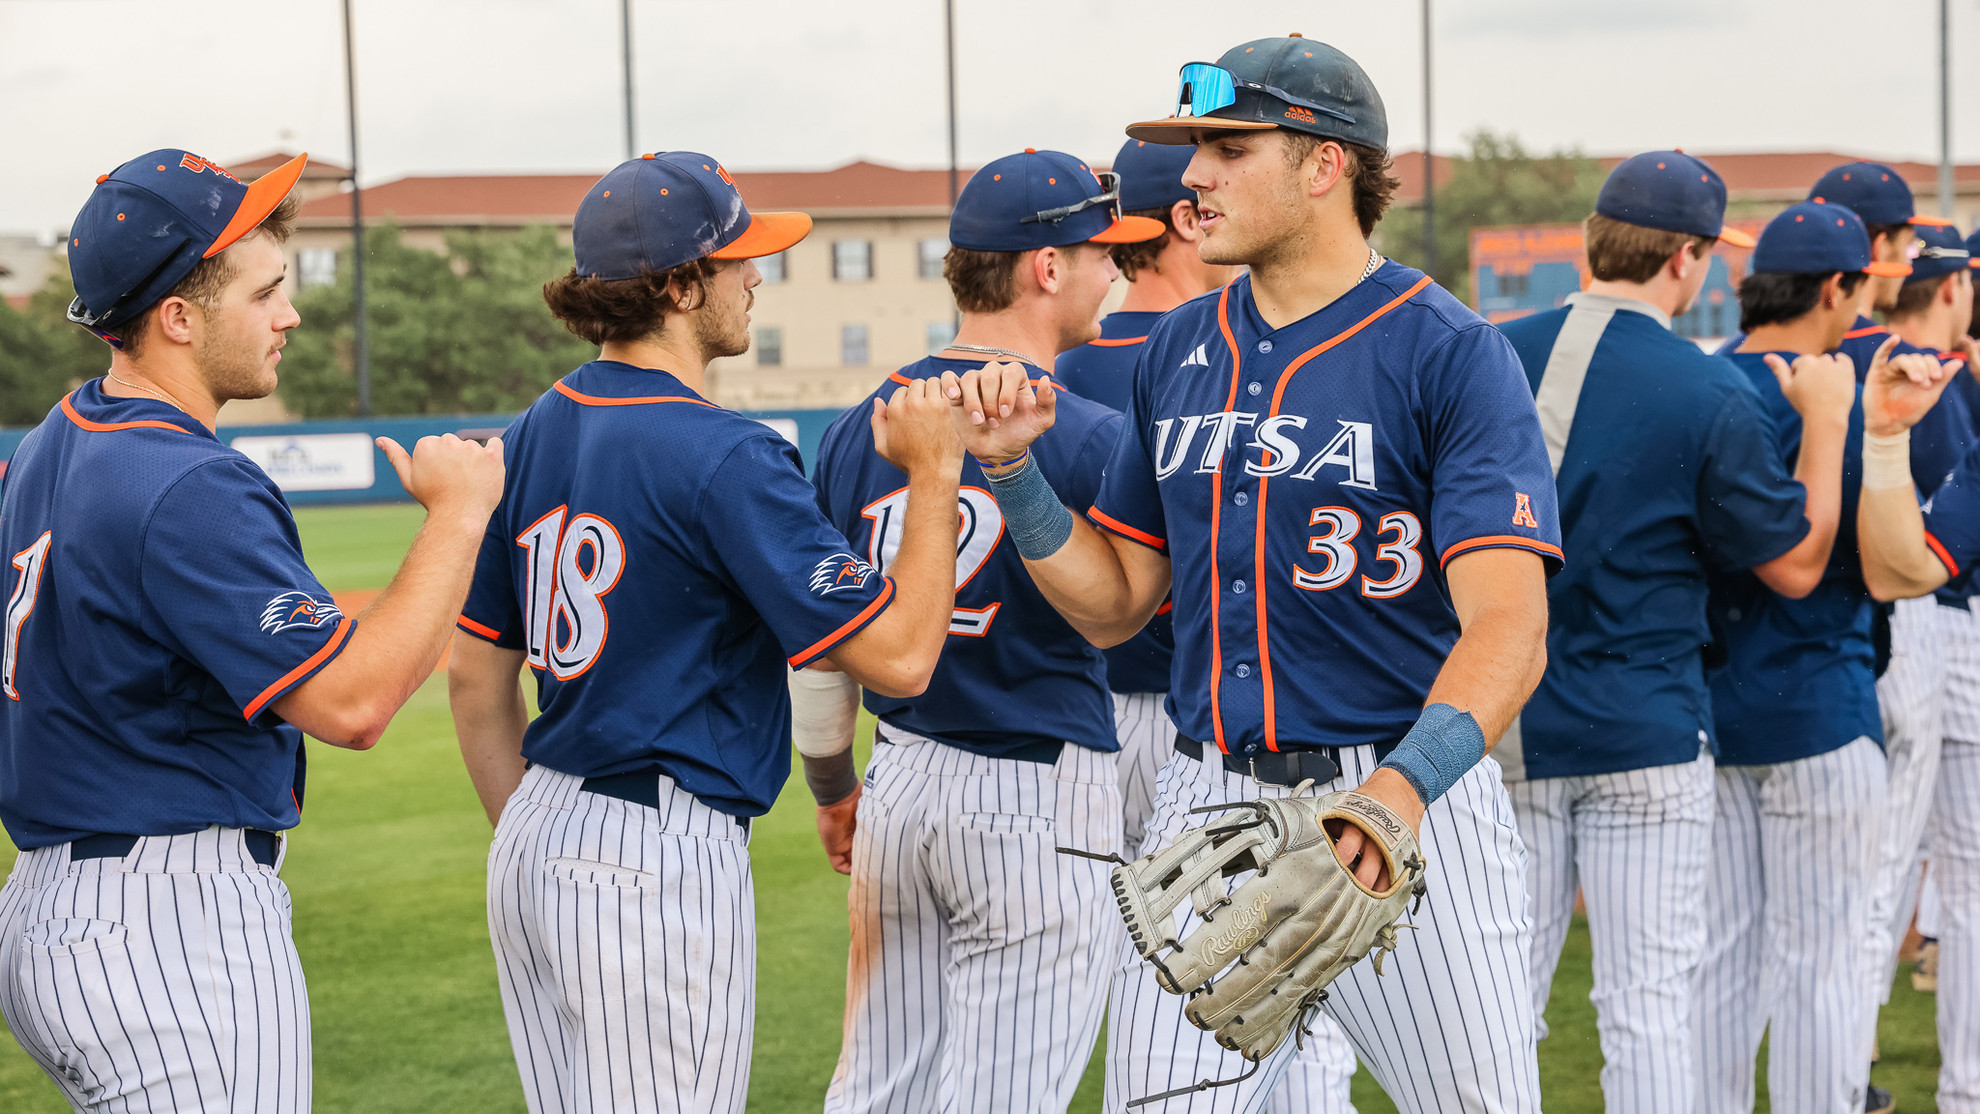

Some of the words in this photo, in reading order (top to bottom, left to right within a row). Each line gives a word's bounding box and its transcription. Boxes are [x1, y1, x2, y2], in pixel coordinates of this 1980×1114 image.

[1284, 110, 1316, 124] adidas
[1155, 411, 1378, 491] UTSA
[515, 504, 626, 681] 18
[1293, 505, 1424, 598] 33
[3, 530, 52, 701] 1
[1201, 888, 1272, 966] Rawlings
